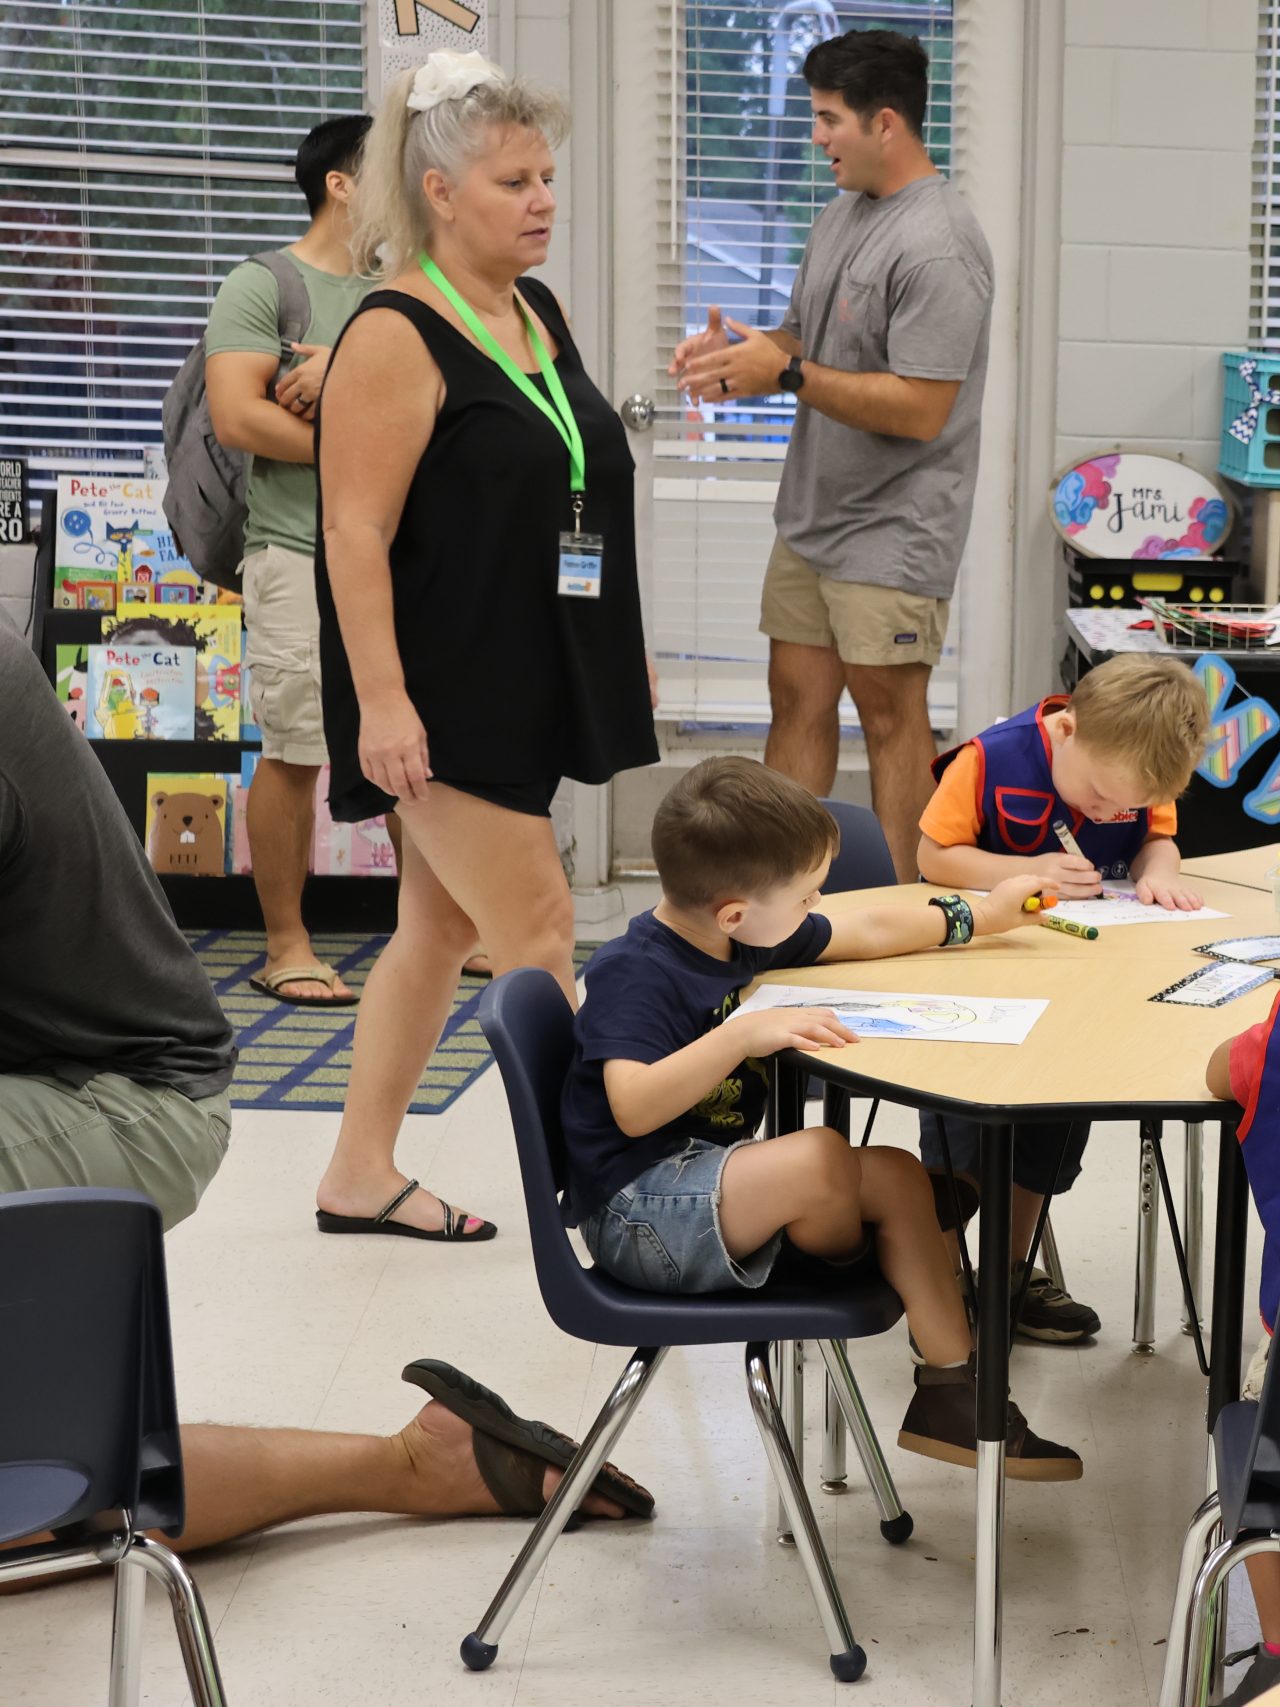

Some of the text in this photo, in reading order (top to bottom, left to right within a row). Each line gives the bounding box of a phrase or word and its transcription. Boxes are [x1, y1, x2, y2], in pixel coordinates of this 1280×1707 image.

[0, 461, 22, 478] ORLD
[71, 480, 108, 497] Pete
[122, 482, 153, 499] Cat
[14, 502, 22, 518] A
[1107, 493, 1185, 534] Jami
[0, 517, 23, 542] RO
[106, 650, 140, 666] Pete
[153, 652, 181, 666] Cat
